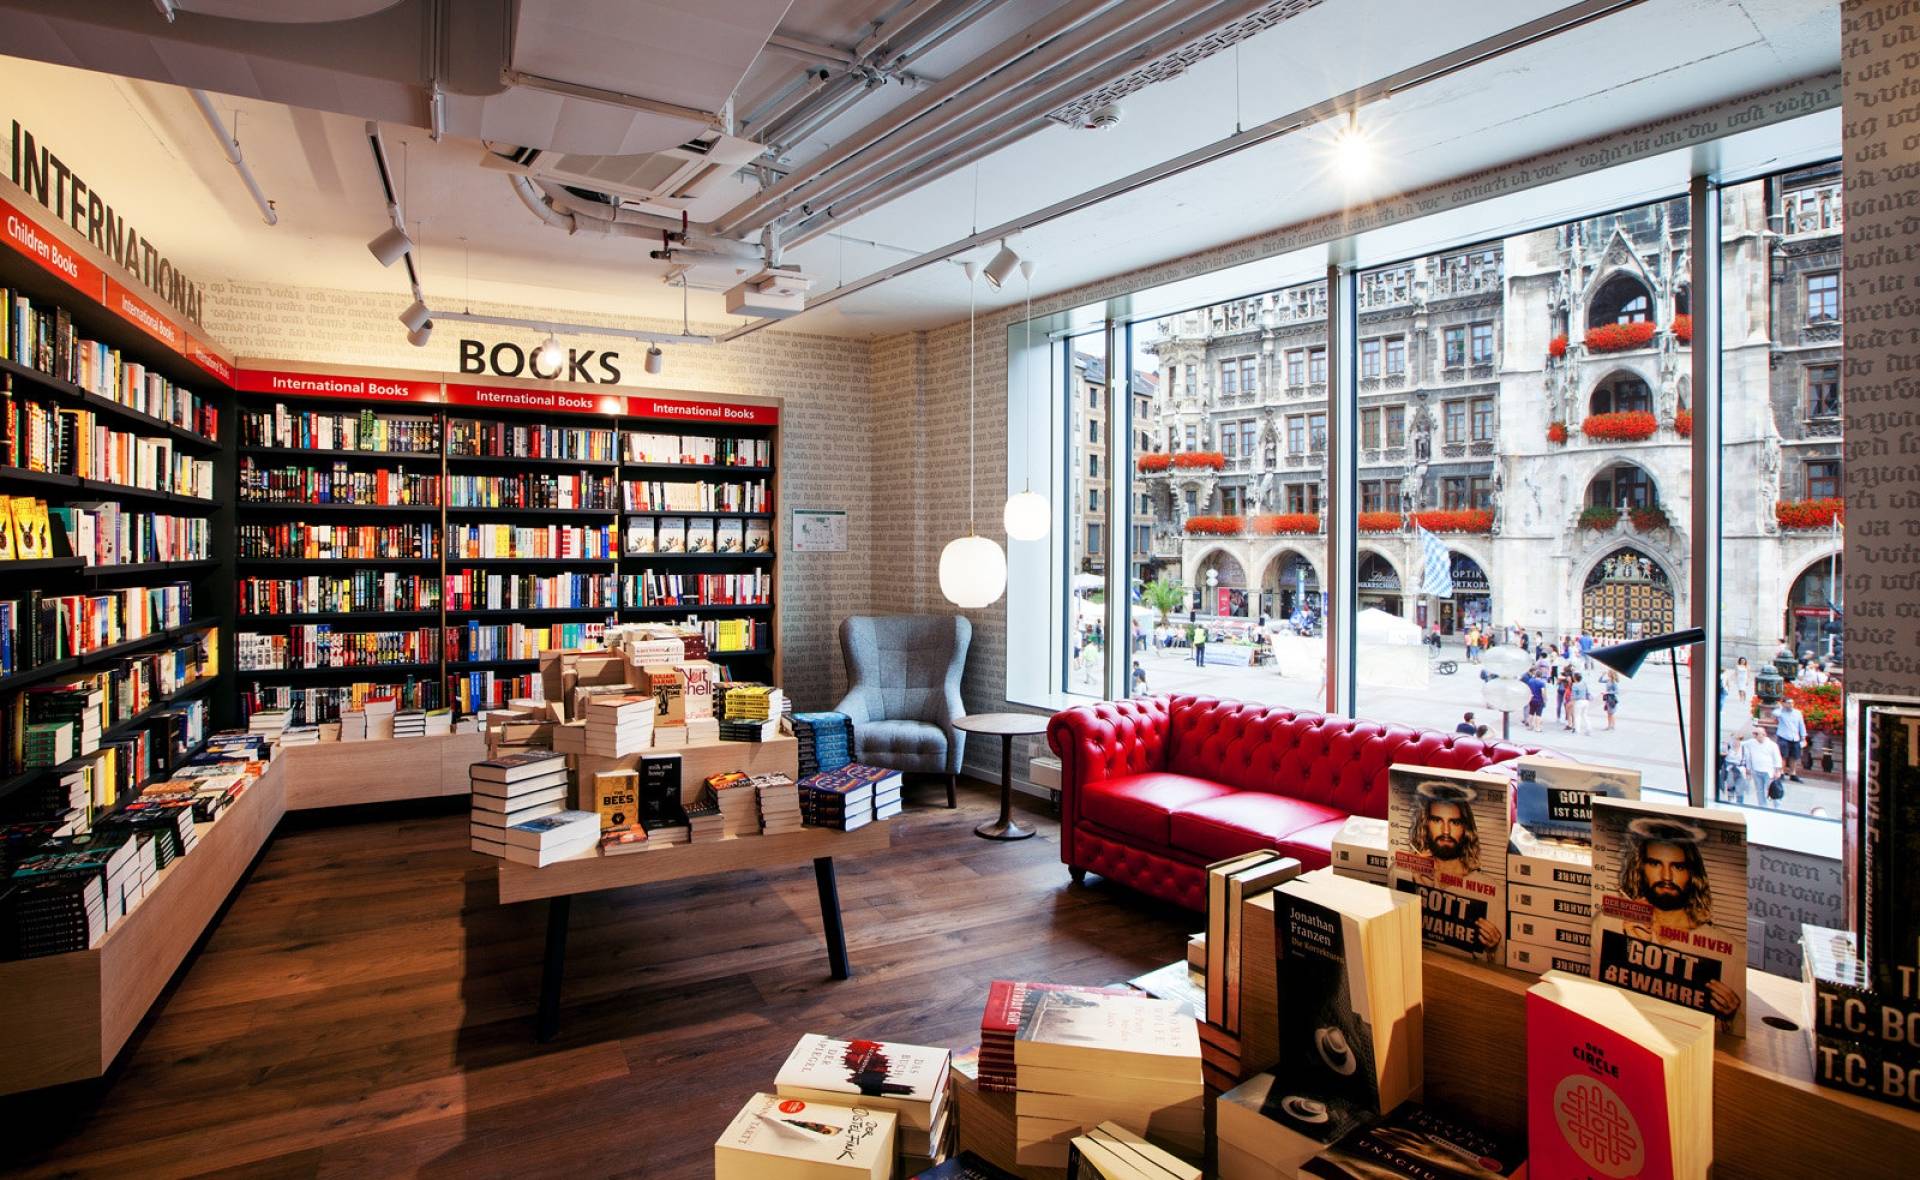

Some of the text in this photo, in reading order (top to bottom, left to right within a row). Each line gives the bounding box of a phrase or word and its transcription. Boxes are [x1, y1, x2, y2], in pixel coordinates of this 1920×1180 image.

[7, 215, 78, 279] Children Books
[121, 294, 175, 342] International Books
[460, 339, 621, 385] BOOKS
[273, 376, 409, 397] International Books
[476, 390, 593, 409] International Books
[653, 402, 755, 420] International Books
[1452, 570, 1483, 578] OPTIK
[684, 680, 711, 695] hell
[603, 794, 635, 806] BEES
[1554, 807, 1592, 819] IST SAU
[1440, 873, 1496, 897] JOHN NIVEN
[1416, 886, 1471, 920] GOTT
[1289, 907, 1335, 934] Jonathan
[1290, 921, 1331, 947] Franzen
[1660, 926, 1733, 955] JOHN NIVEN
[1628, 940, 1699, 980] GOTT
[1604, 964, 1705, 1008] BEWAHRE
[1818, 991, 1875, 1037] T.C.
[822, 1048, 839, 1066] DER
[894, 1053, 911, 1077] BUCH
[911, 1058, 925, 1074] DAS
[1572, 1046, 1620, 1079] CIRCLE
[1818, 1045, 1875, 1092] T.C.
[1359, 1139, 1436, 1180] UNSCHU
